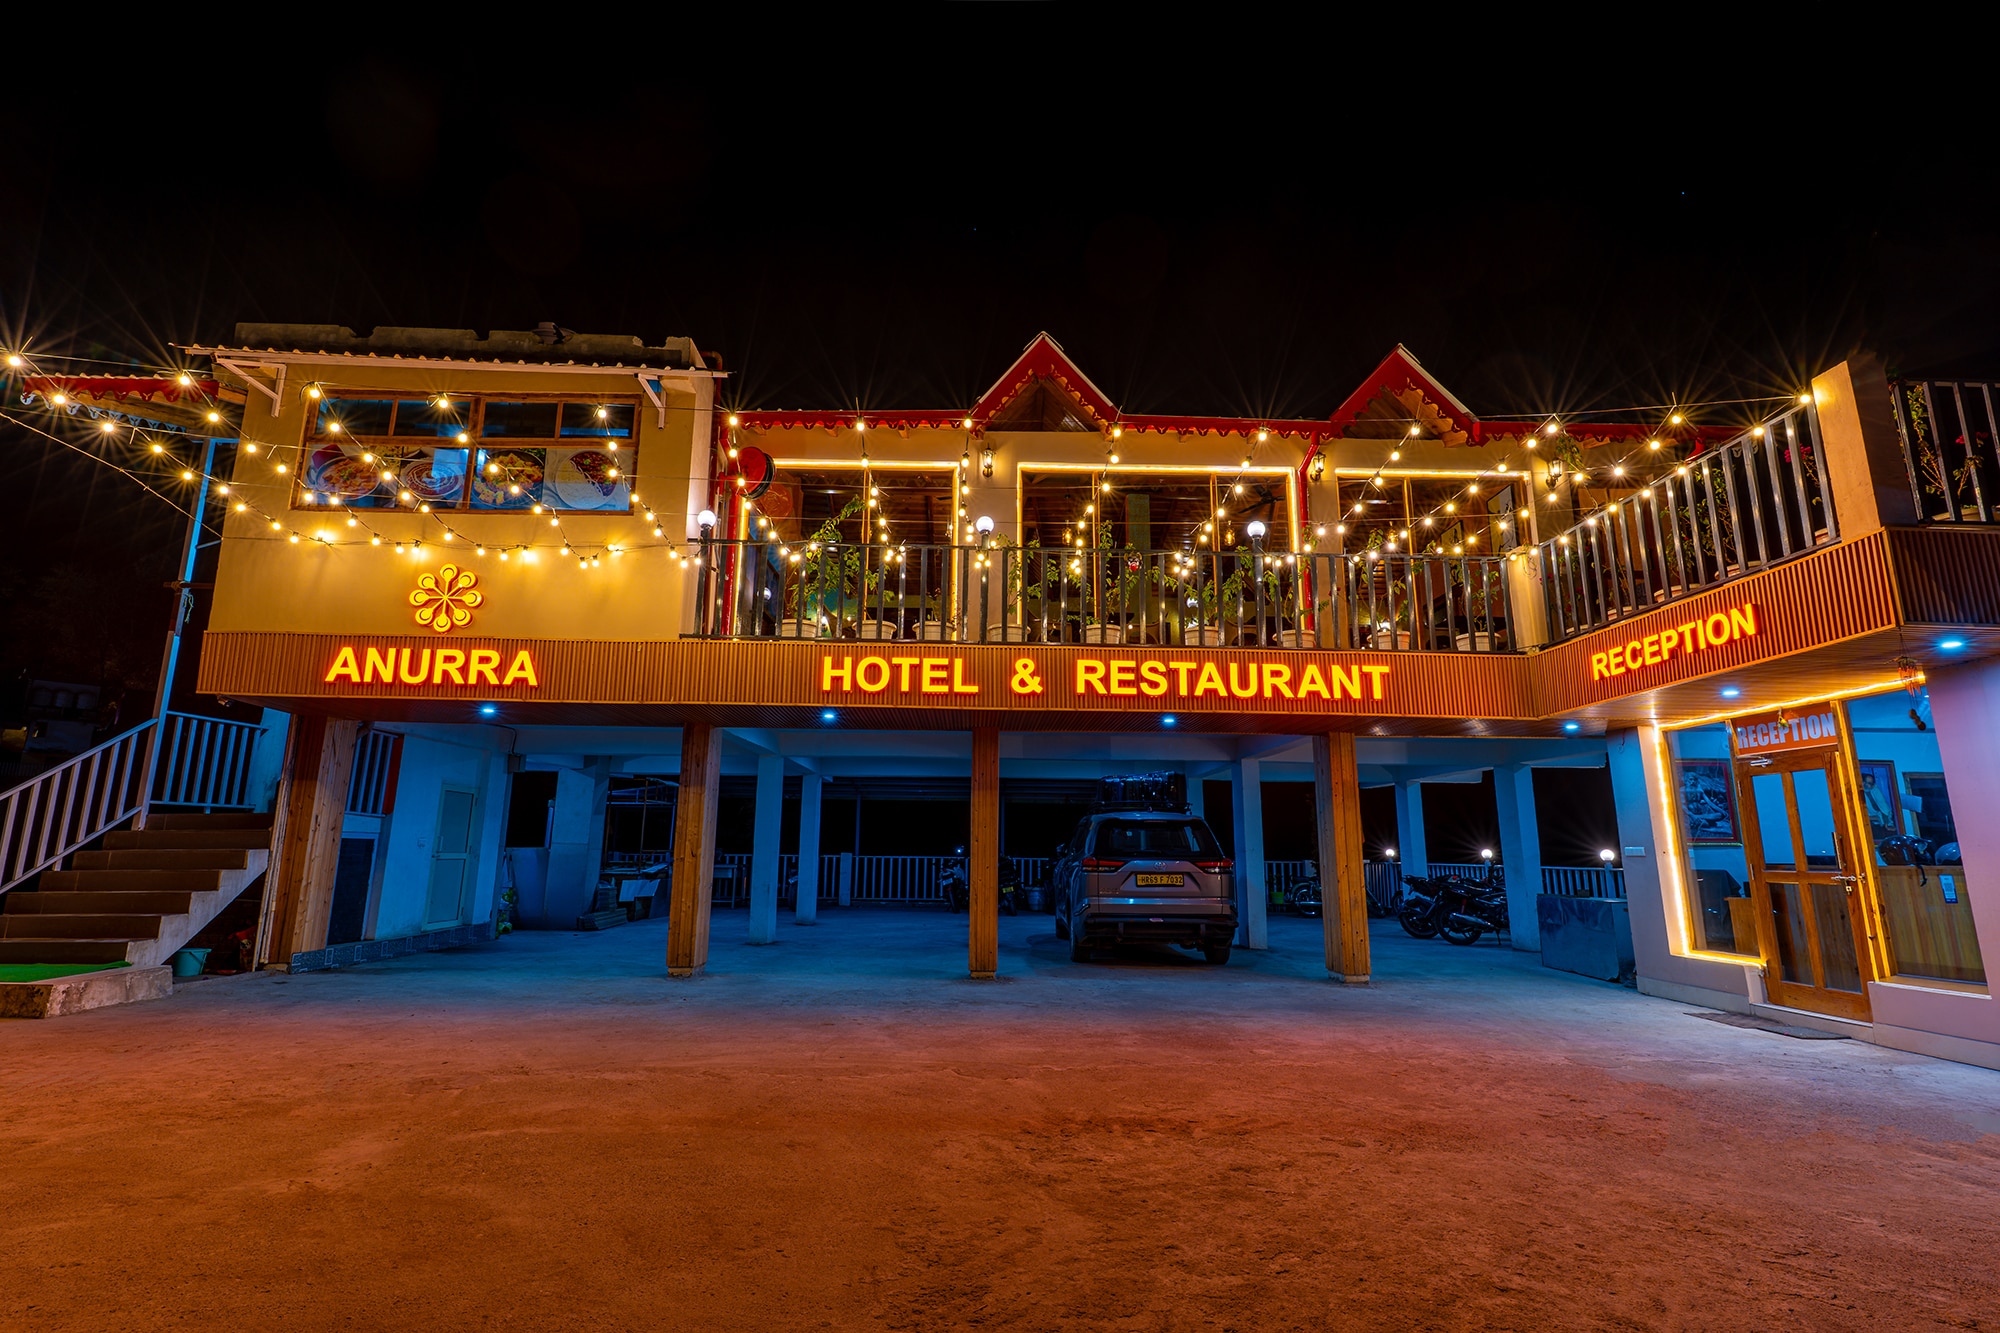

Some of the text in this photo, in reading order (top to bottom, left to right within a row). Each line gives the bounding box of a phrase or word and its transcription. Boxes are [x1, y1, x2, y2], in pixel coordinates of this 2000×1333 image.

[1591, 603, 1756, 681] RECEPTION
[324, 646, 1389, 699] ANURRA HOTEL & RESTAURANT
[1736, 712, 1836, 749] RECEPTION
